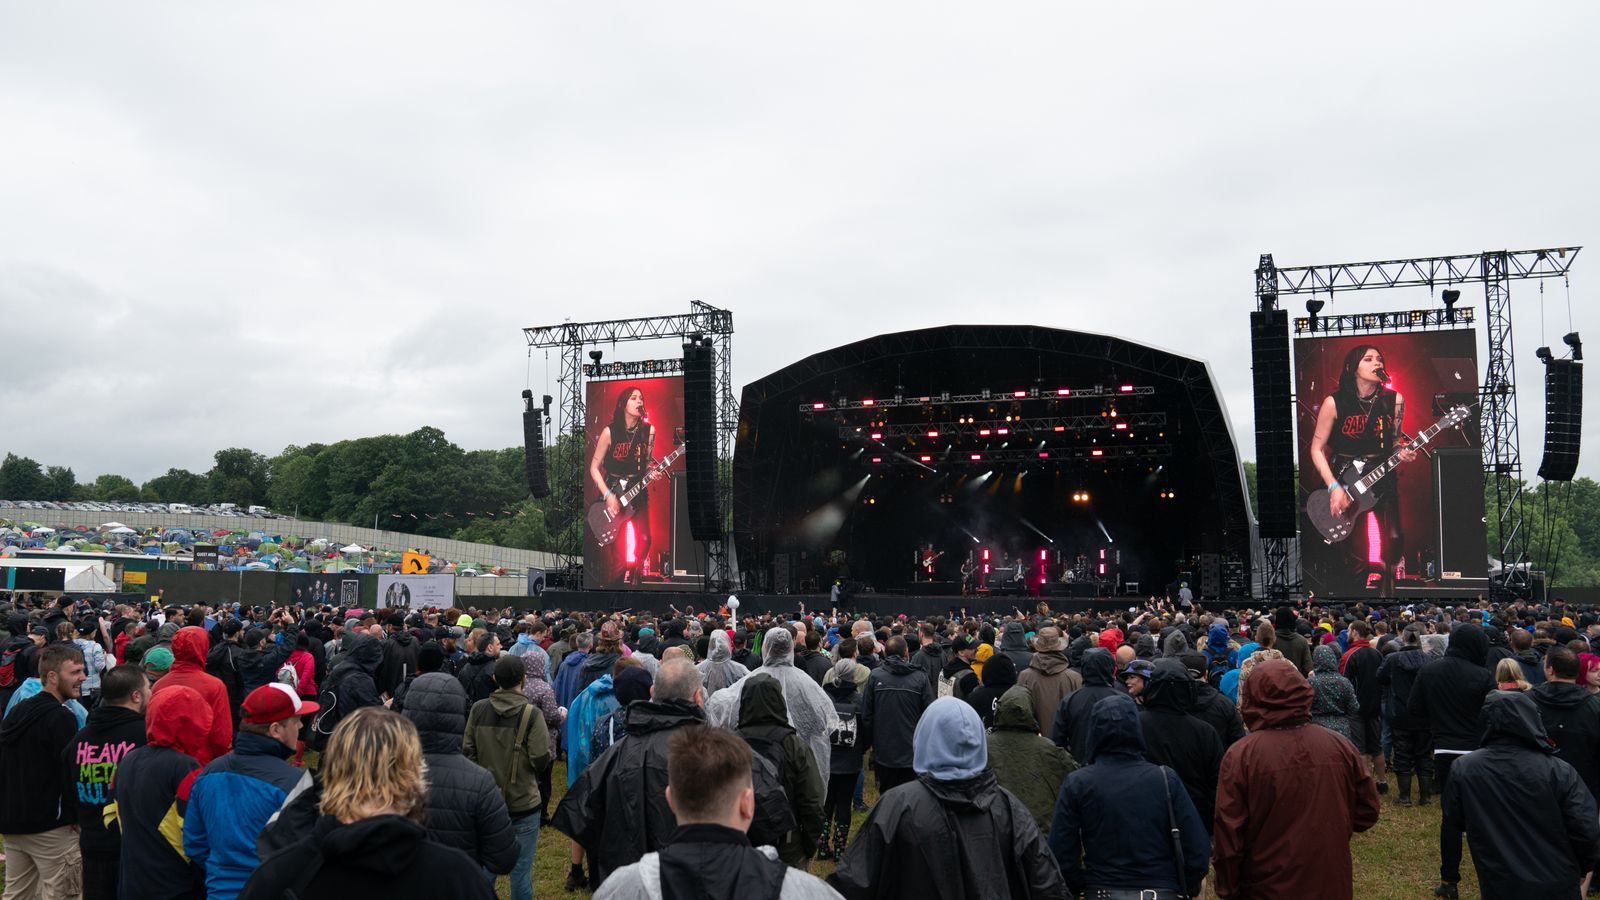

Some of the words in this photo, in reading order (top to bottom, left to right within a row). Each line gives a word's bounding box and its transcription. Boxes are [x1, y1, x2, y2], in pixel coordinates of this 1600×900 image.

[76, 741, 135, 765] HEAVY
[80, 762, 117, 783] MET
[77, 781, 110, 804] RUL
